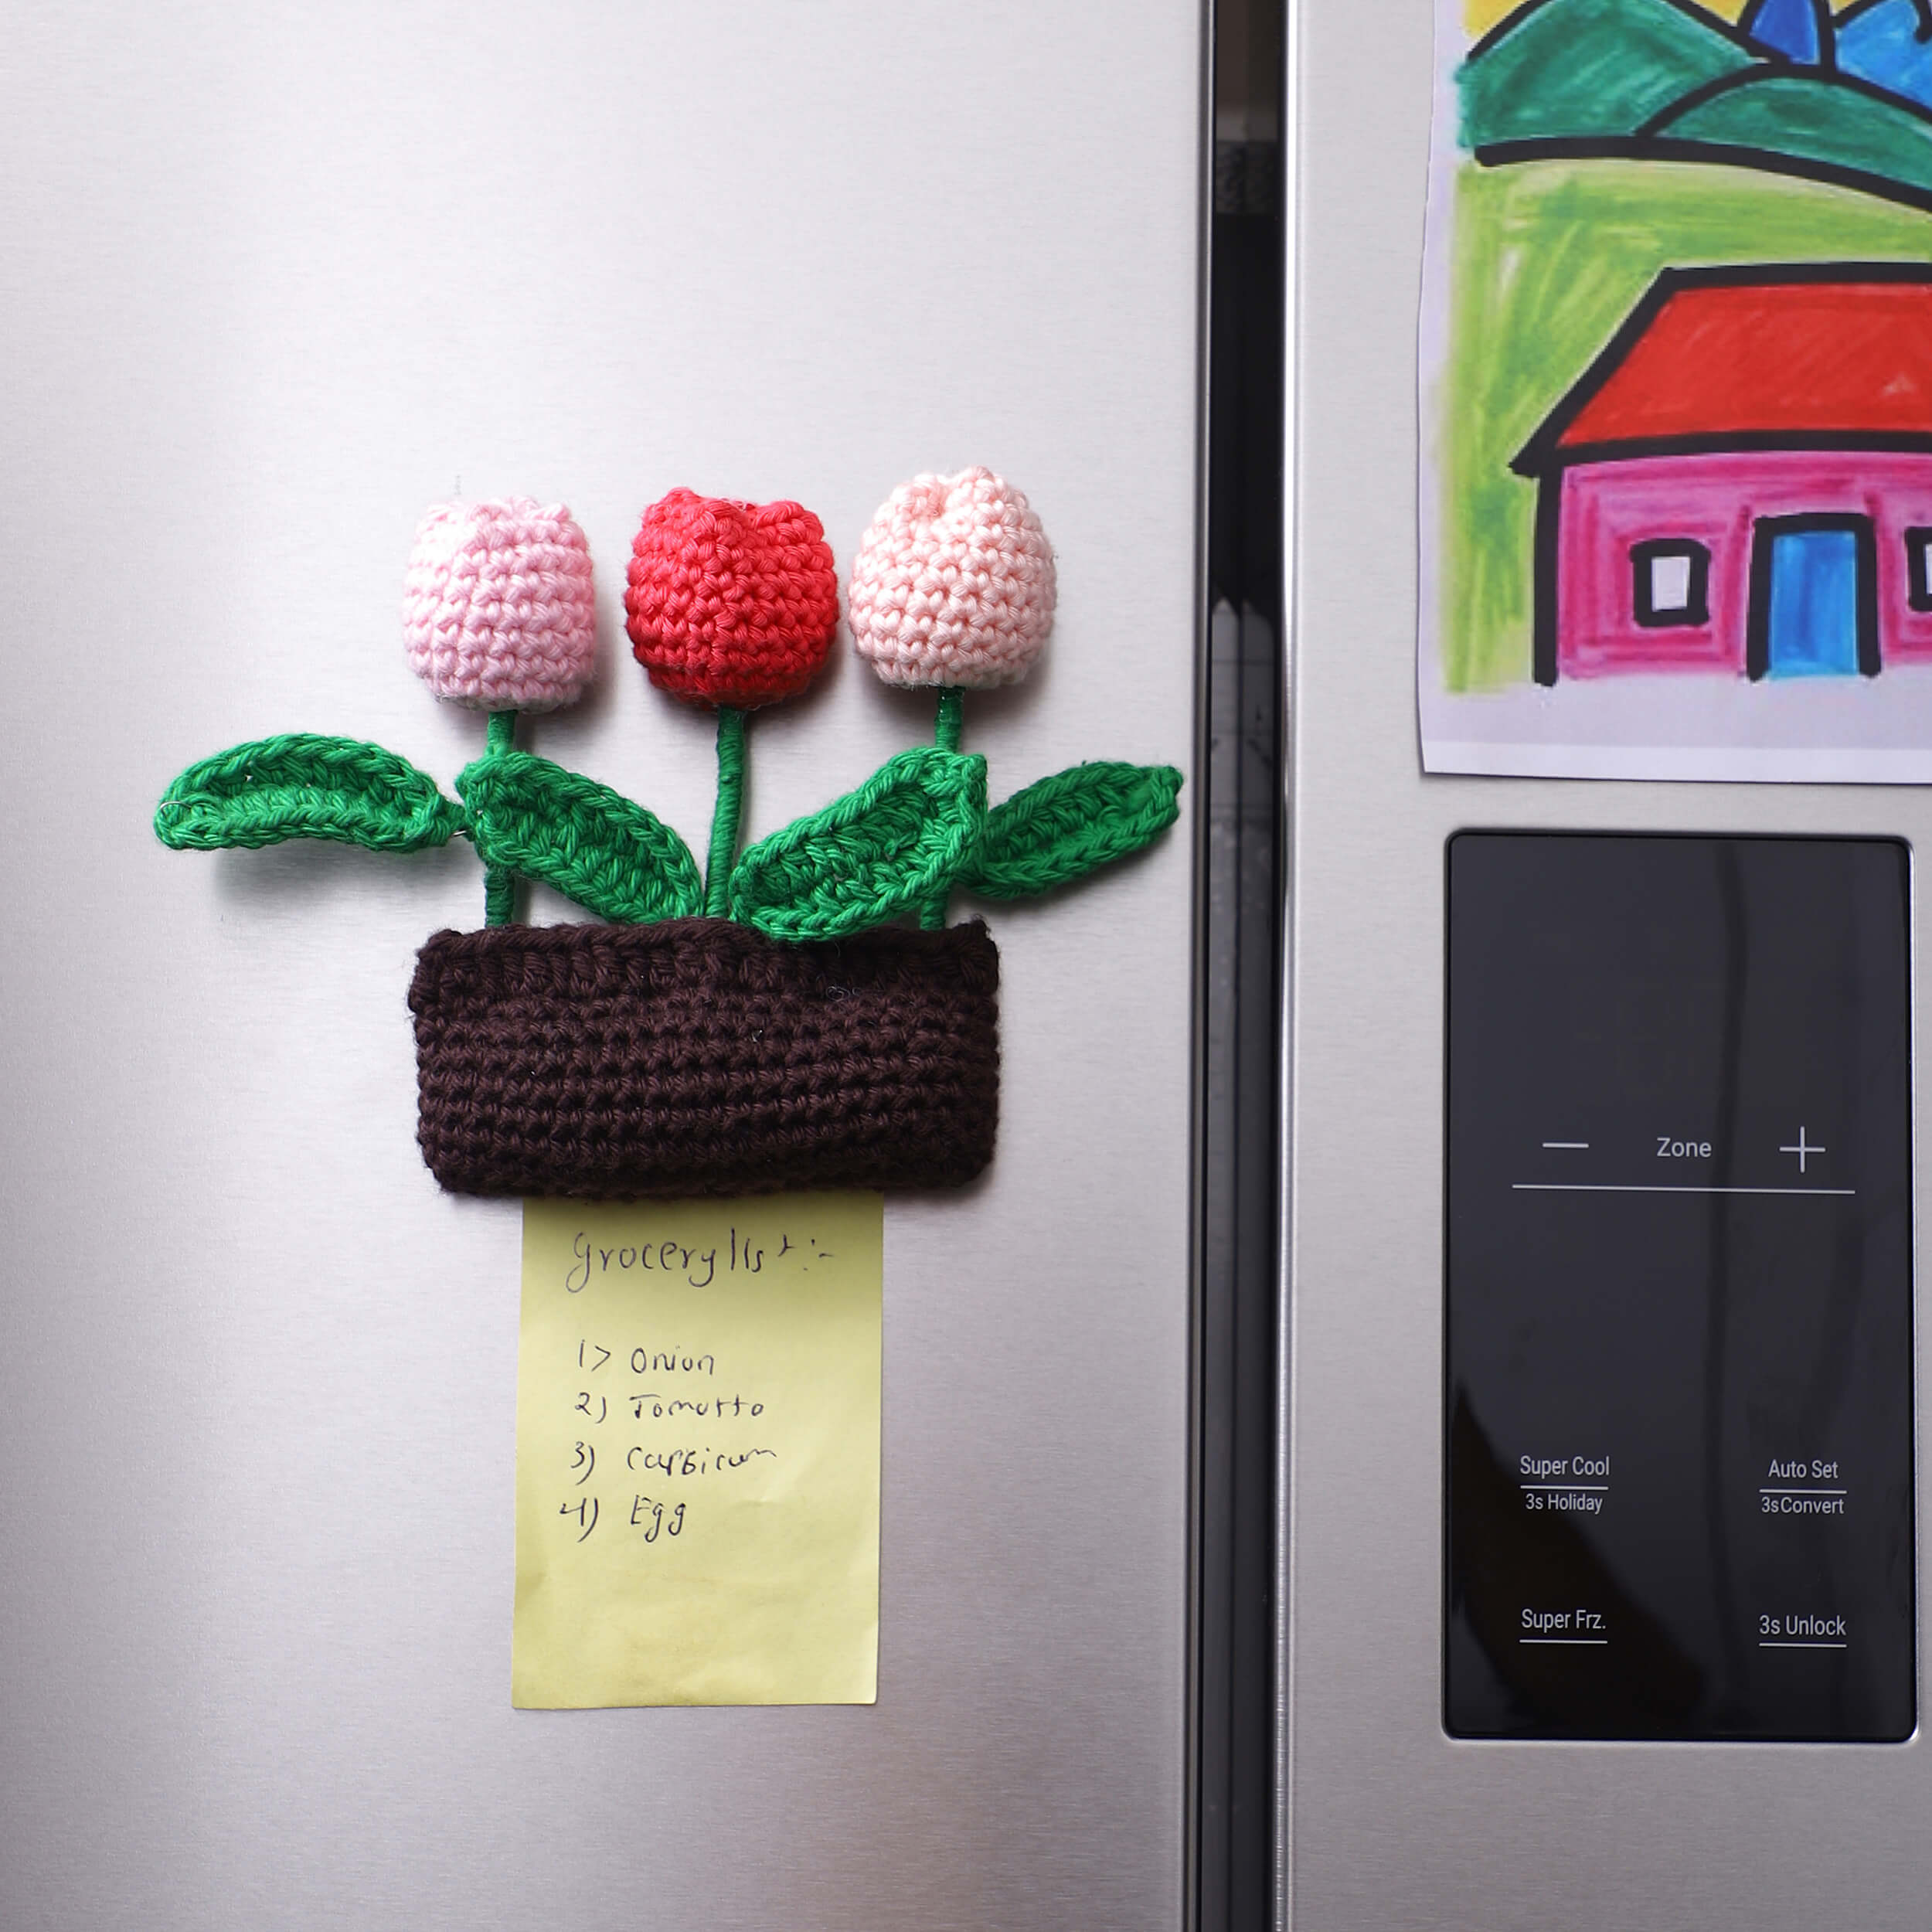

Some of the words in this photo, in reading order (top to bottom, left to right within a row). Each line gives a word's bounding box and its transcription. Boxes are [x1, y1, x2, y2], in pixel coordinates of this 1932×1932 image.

[1656, 1137, 1713, 1158] Zone
[630, 1344, 715, 1376] Onion
[574, 1391, 608, 1425] 2)
[570, 1440, 597, 1487] 3)
[1519, 1455, 1569, 1481] Super
[1572, 1455, 1611, 1477] Cool
[1767, 1458, 1807, 1479] Auto
[1811, 1459, 1839, 1479] Set
[1526, 1493, 1544, 1511] 3s
[1547, 1492, 1604, 1515] Holiday
[559, 1497, 600, 1544] 4)
[630, 1494, 688, 1544] Egg
[1521, 1608, 1572, 1634] Super
[1576, 1609, 1607, 1631] Frz.
[1759, 1614, 1781, 1636] 3s
[1786, 1614, 1847, 1637] Unlock
